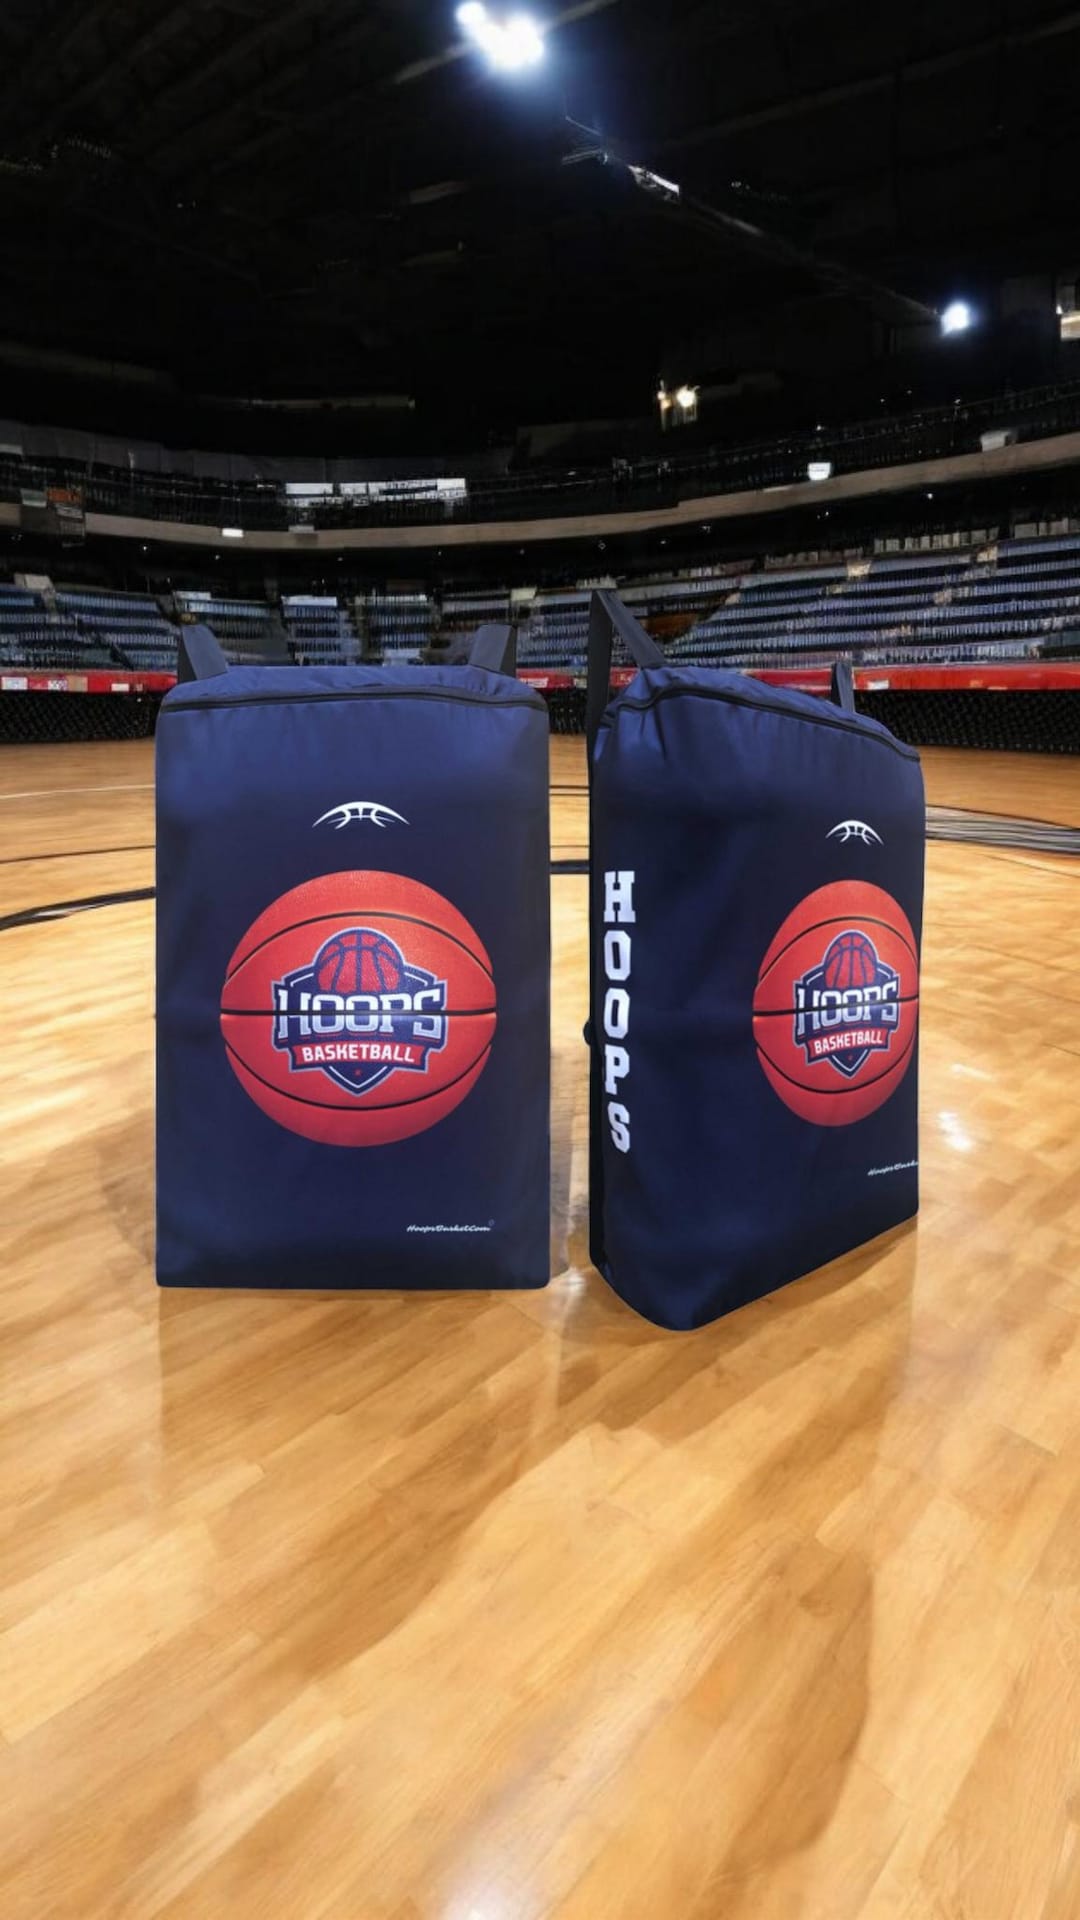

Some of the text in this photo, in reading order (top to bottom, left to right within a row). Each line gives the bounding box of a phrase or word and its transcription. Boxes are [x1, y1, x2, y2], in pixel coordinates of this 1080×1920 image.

[277, 988, 442, 1040] HOOPS
[603, 870, 636, 1154] HOOPS
[797, 980, 897, 1036] HOOPS
[301, 1043, 415, 1063] BASKETBALL
[814, 1030, 883, 1054] BASKETBALL
